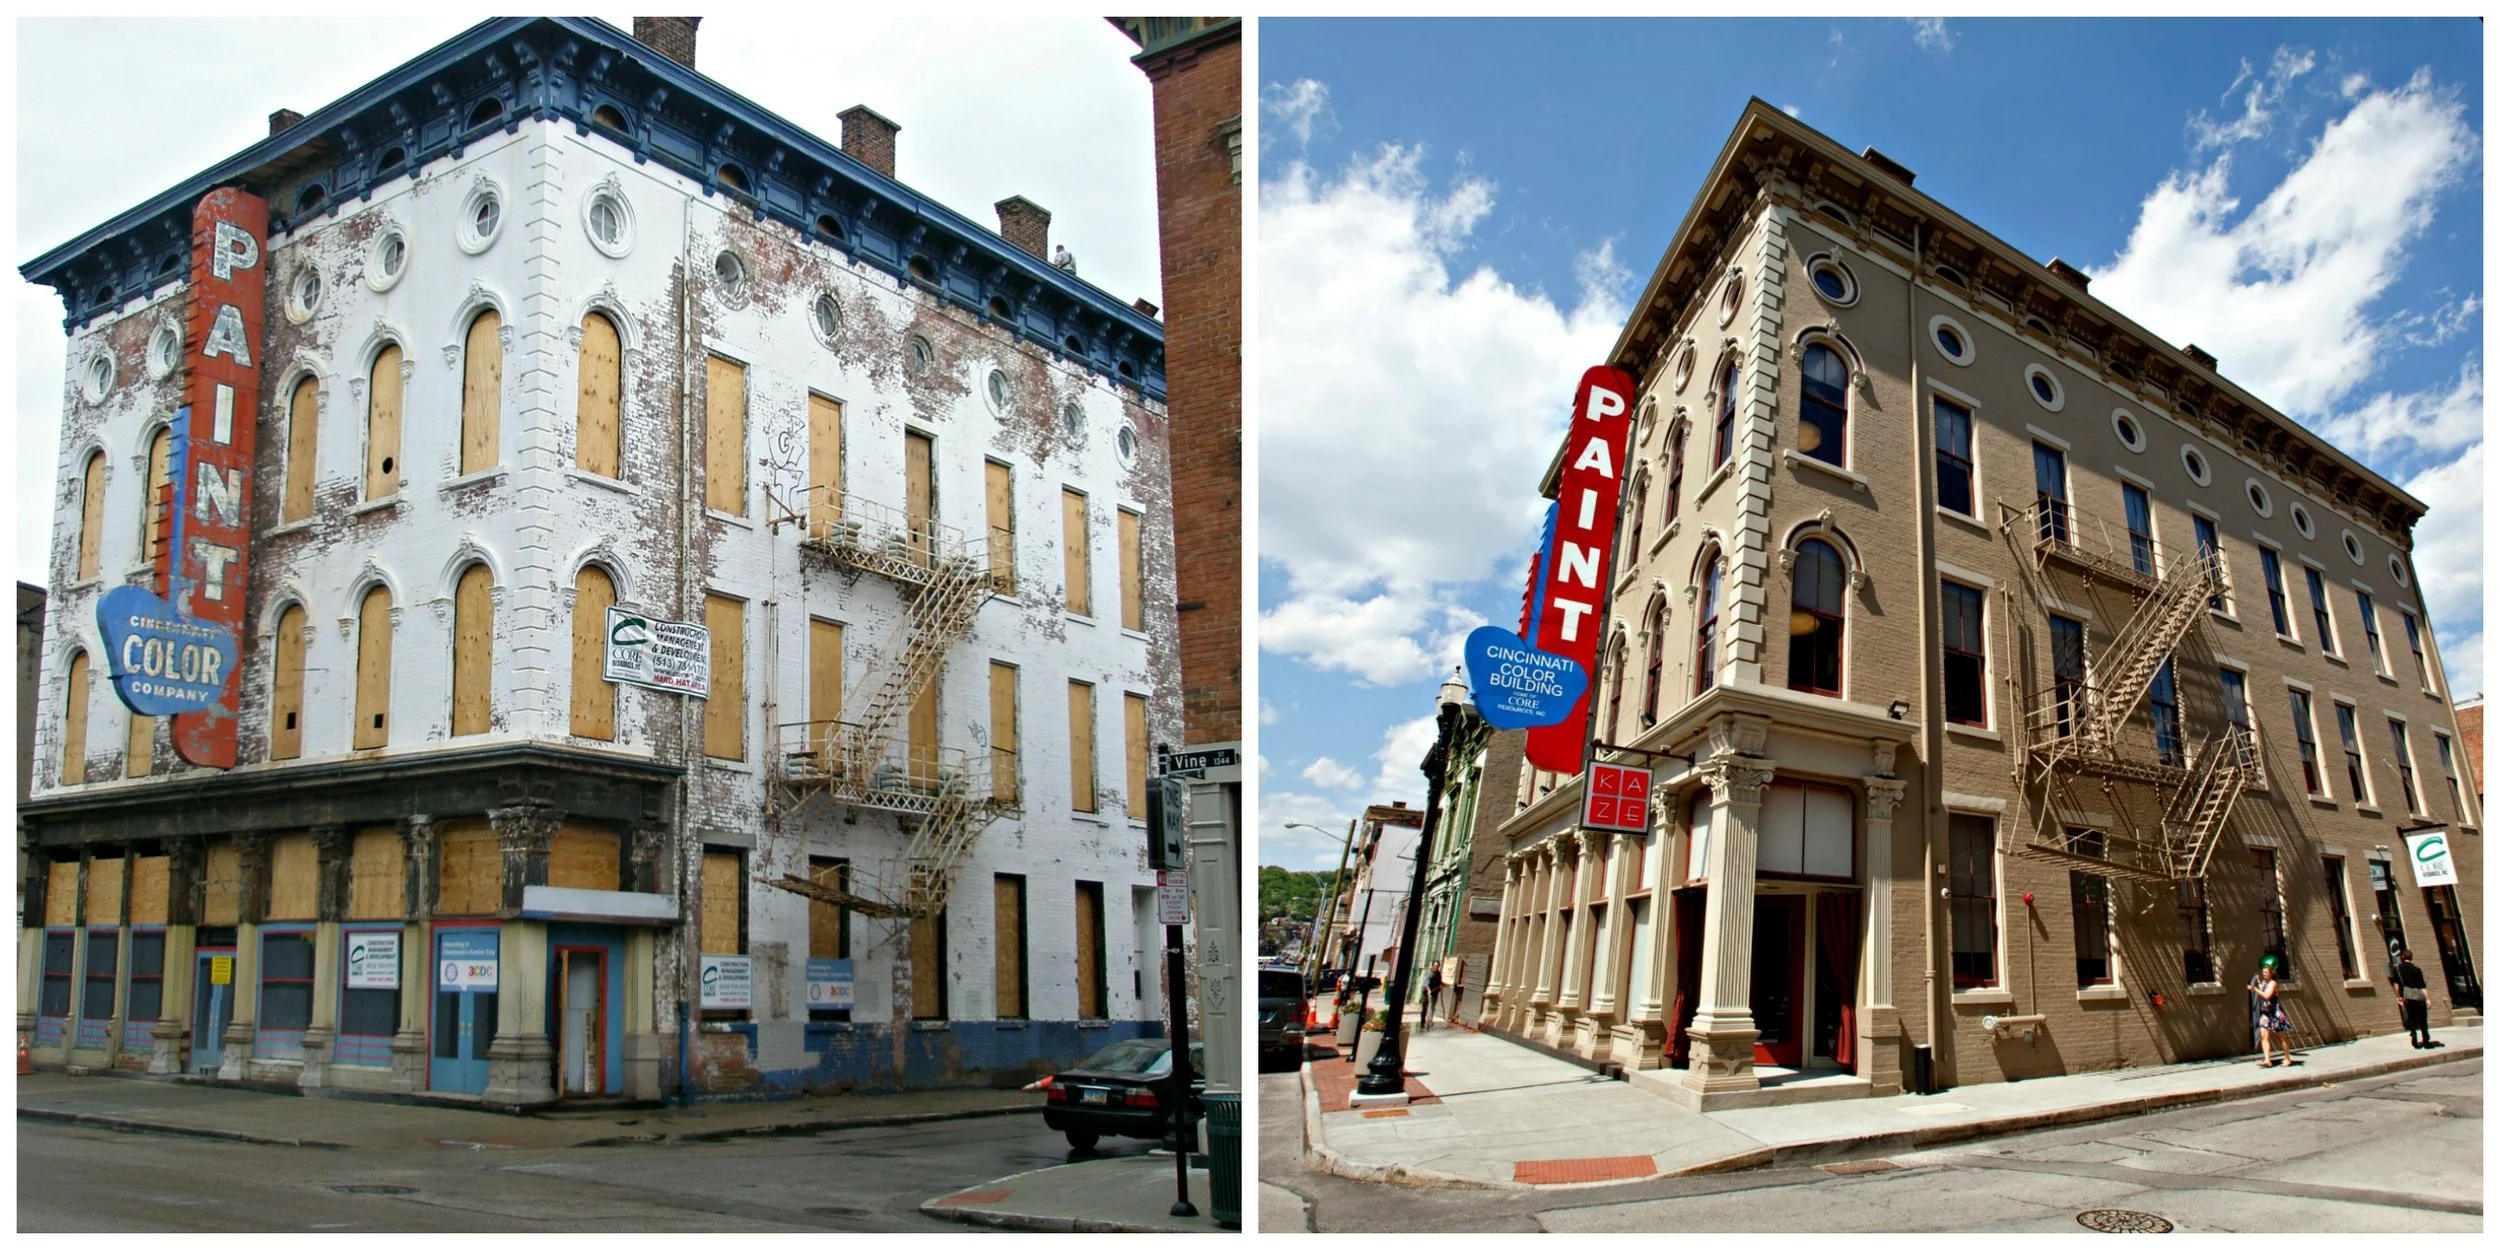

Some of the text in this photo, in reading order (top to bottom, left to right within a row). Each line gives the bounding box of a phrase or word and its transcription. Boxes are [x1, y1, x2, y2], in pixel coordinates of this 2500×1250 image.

[192, 220, 260, 602] PAINT
[1553, 384, 1626, 643] PAINT
[122, 633, 222, 687] COLOR
[652, 655, 676, 671] (513)
[1486, 645, 1575, 673] CINCINNATI
[652, 674, 674, 685] HARD
[675, 679, 690, 688] HAT
[1500, 662, 1556, 684] COLOR
[131, 681, 209, 702] COMPANY
[1489, 672, 1563, 697] BUILDING
[1507, 696, 1540, 710] CORE
[1174, 755, 1207, 769] Vine
[1165, 786, 1180, 809] ONE
[1166, 811, 1180, 832] WAY
[468, 965, 493, 977] 3CDC
